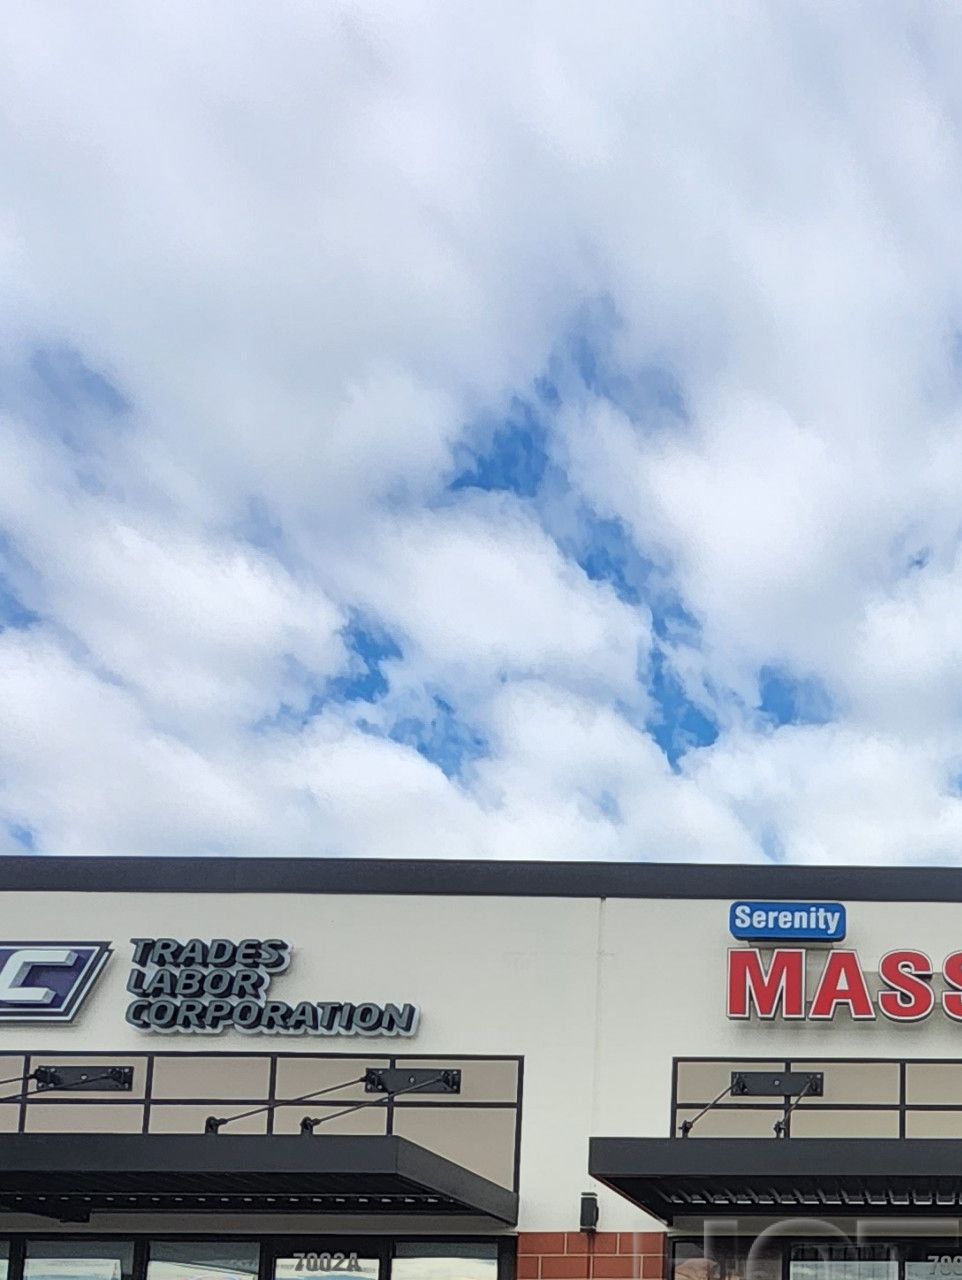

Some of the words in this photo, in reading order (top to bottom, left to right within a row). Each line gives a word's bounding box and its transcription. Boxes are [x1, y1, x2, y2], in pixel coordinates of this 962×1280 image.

[734, 905, 841, 934] Serenity
[130, 938, 291, 968] TRADES
[126, 968, 267, 999] LABOR
[125, 1001, 418, 1035] CORPORATION
[293, 1252, 362, 1272] 7002A
